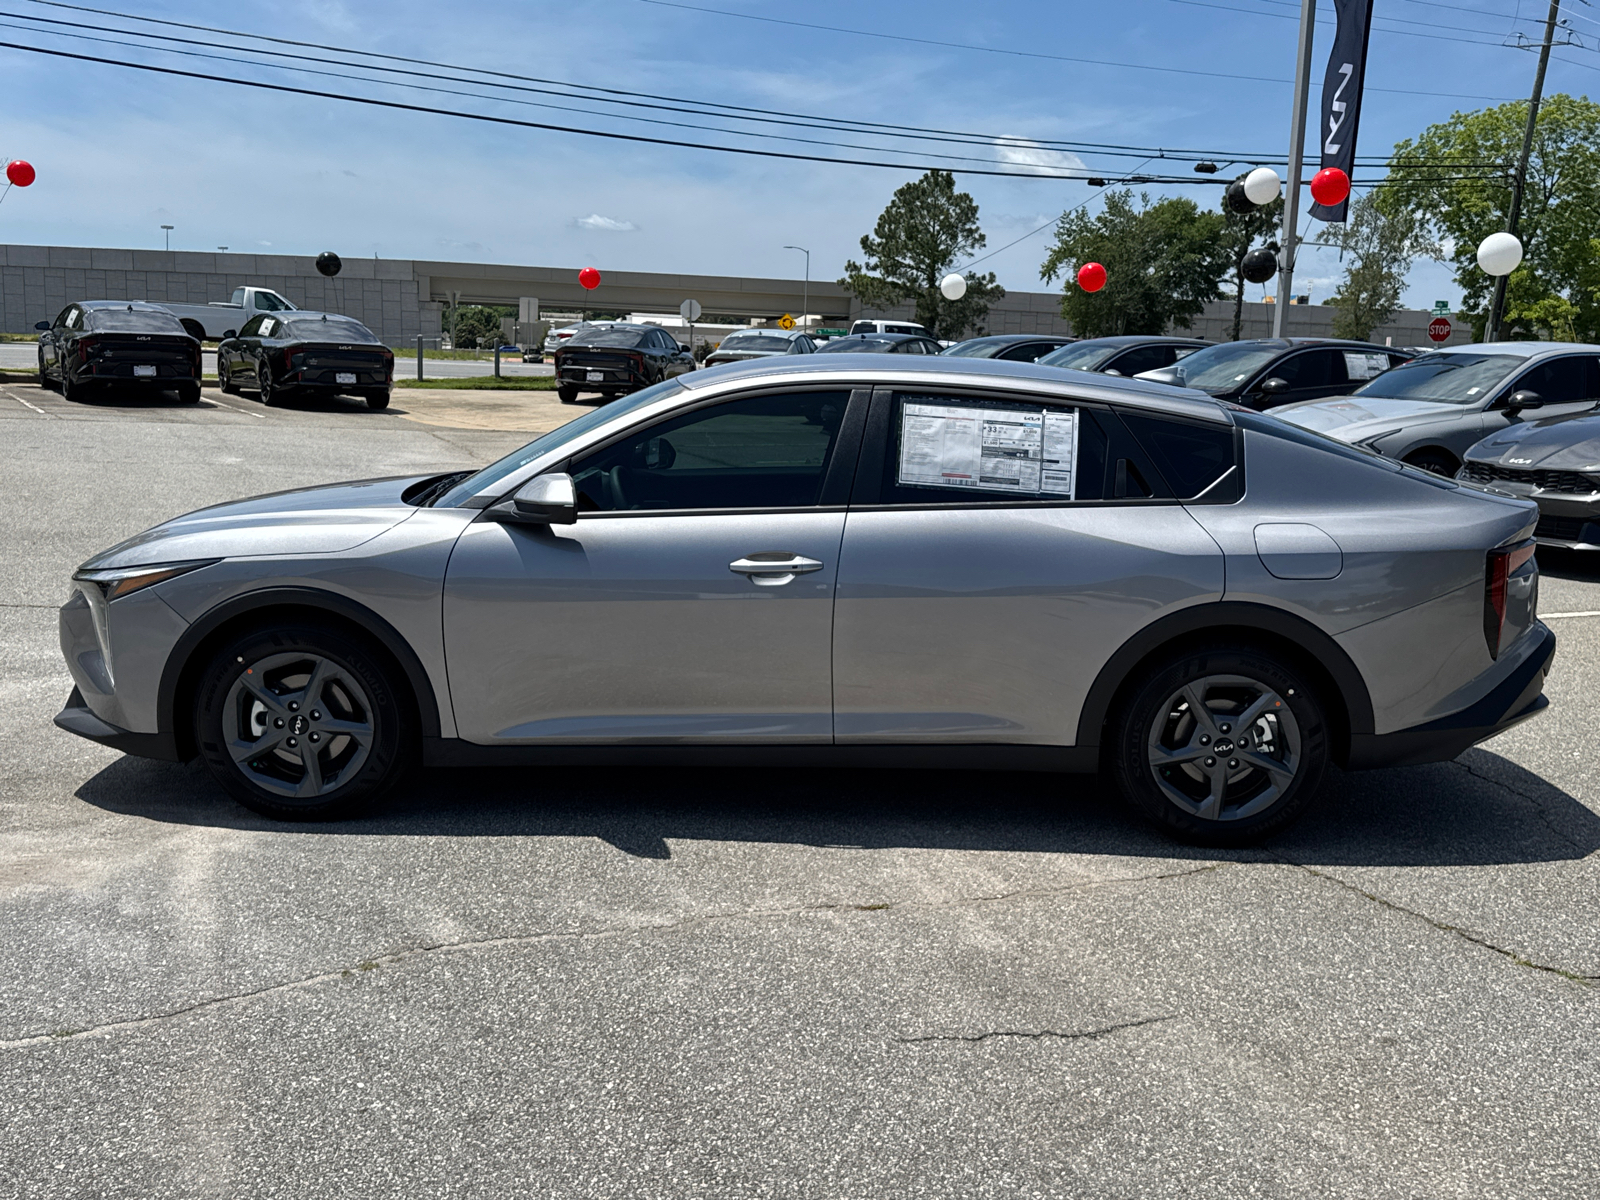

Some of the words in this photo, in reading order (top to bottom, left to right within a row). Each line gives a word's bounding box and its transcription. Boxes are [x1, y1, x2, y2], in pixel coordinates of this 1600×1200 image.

[1429, 324, 1451, 336] STOP
[987, 425, 998, 433] 33
[1508, 457, 1533, 465] KIA
[346, 655, 388, 706] KUMHO
[294, 715, 303, 735] KIA
[1130, 720, 1143, 778] SOLUS
[1214, 743, 1233, 752] KIA
[1246, 799, 1301, 836] KUMHO
